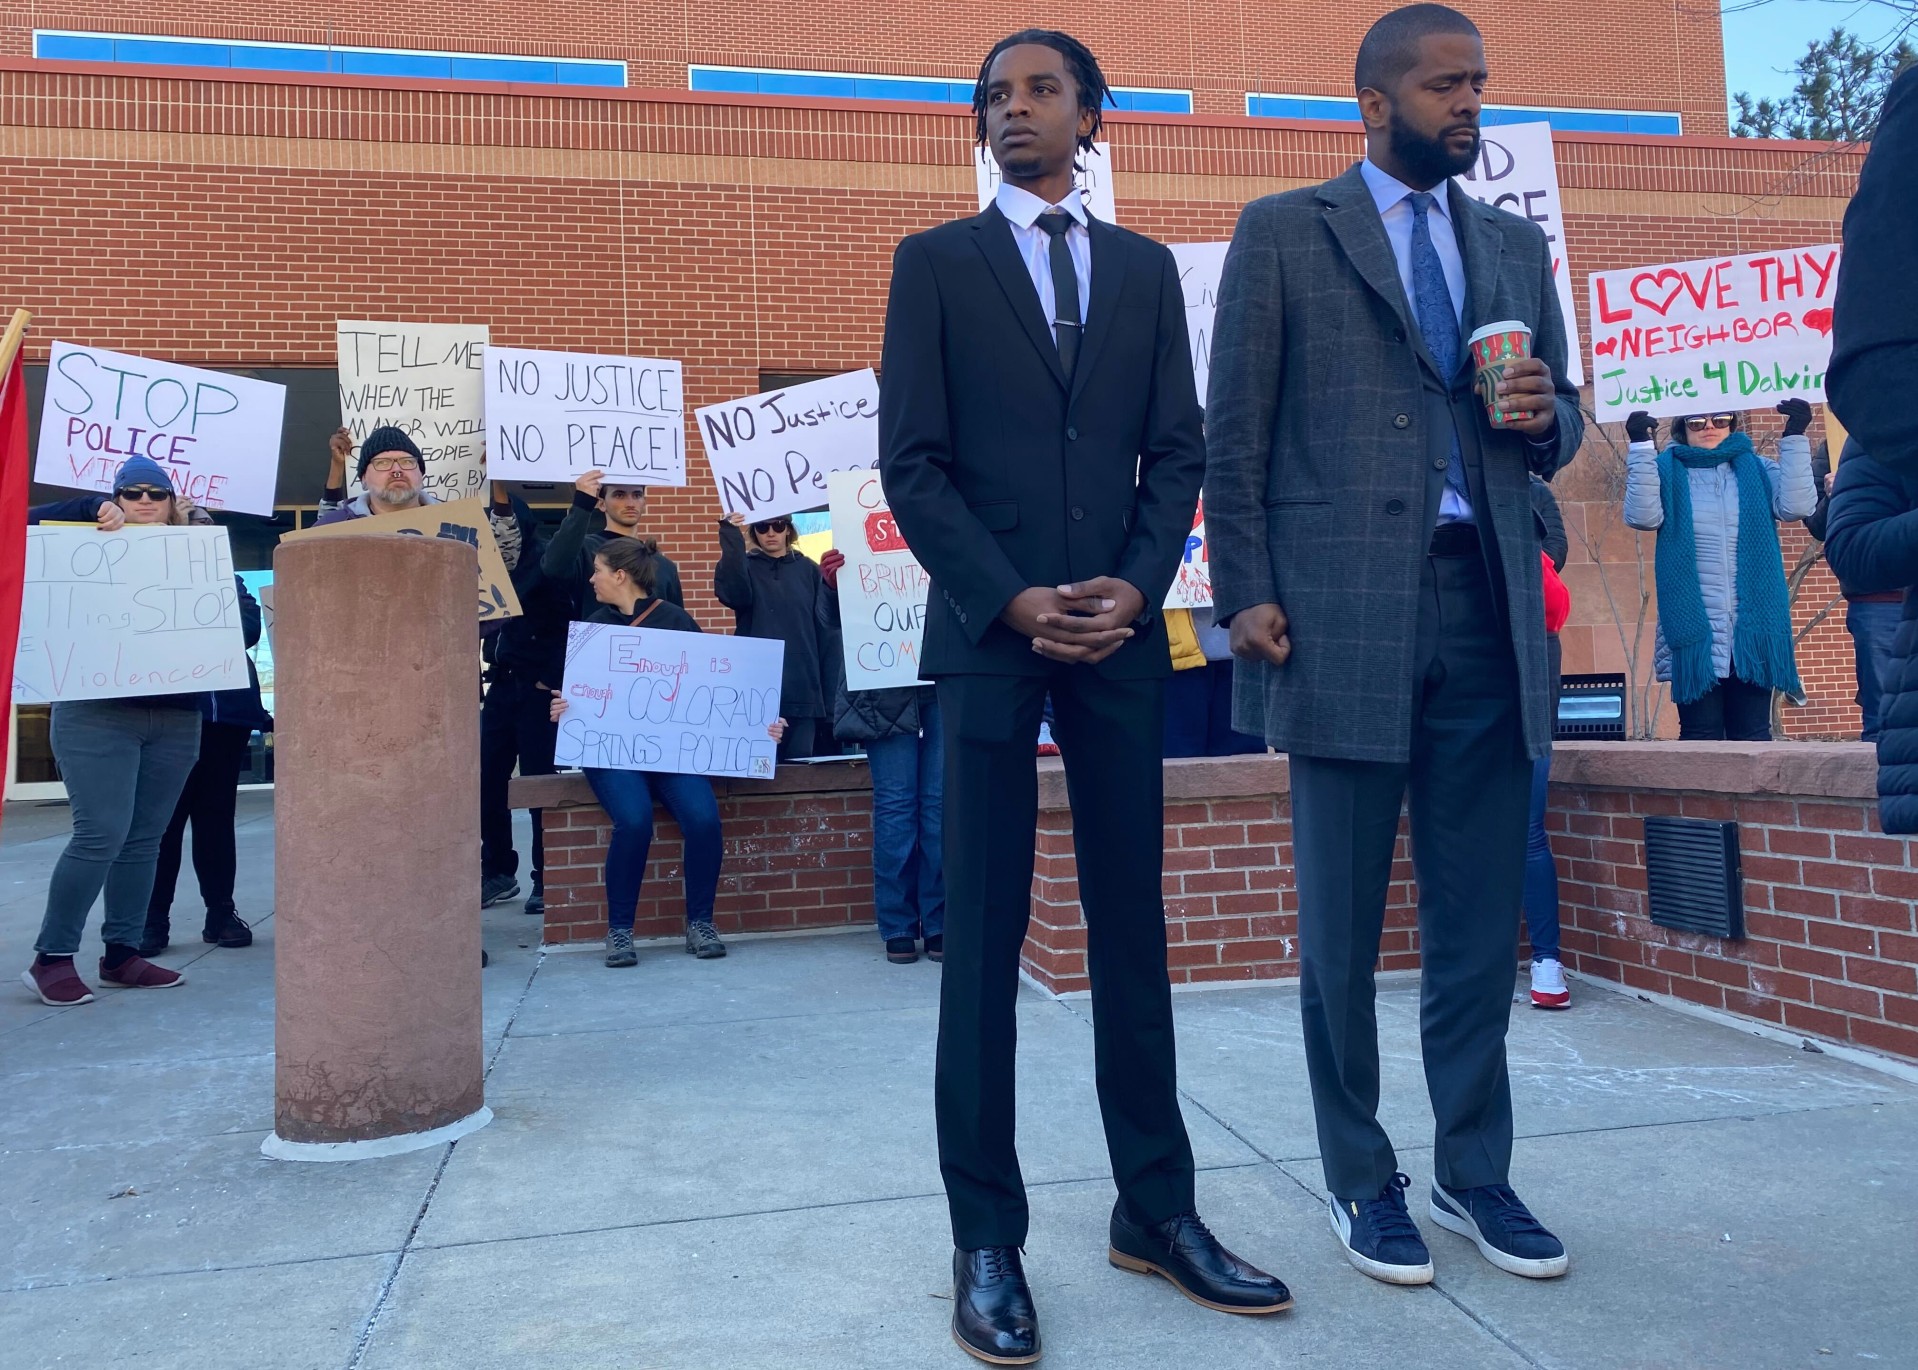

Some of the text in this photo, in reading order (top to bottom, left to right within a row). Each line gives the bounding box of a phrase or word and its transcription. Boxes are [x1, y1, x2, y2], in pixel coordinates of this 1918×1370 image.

[1748, 251, 1837, 303] THY
[338, 331, 485, 377] TELL ME
[1620, 312, 1799, 360] NEIGHBOR
[54, 352, 238, 434] STOP
[339, 384, 455, 412] WHEN THE
[499, 359, 683, 417] NO JUSTICE,
[1601, 368, 1698, 406] Justice
[1703, 360, 1727, 394] 4
[67, 416, 197, 465] POLICE
[434, 418, 486, 437] WILL
[704, 392, 879, 450] NO Justice
[500, 424, 680, 471] NO PEACE!
[69, 454, 228, 508] VINCE
[467, 469, 487, 489] BY
[722, 467, 775, 514] NO
[138, 533, 233, 583] THE
[133, 584, 237, 633] STOP
[609, 635, 732, 702] Enough is
[857, 641, 922, 671] COM
[570, 676, 779, 729] enough COLORADO
[555, 718, 772, 778] SPRINGS POLICE
